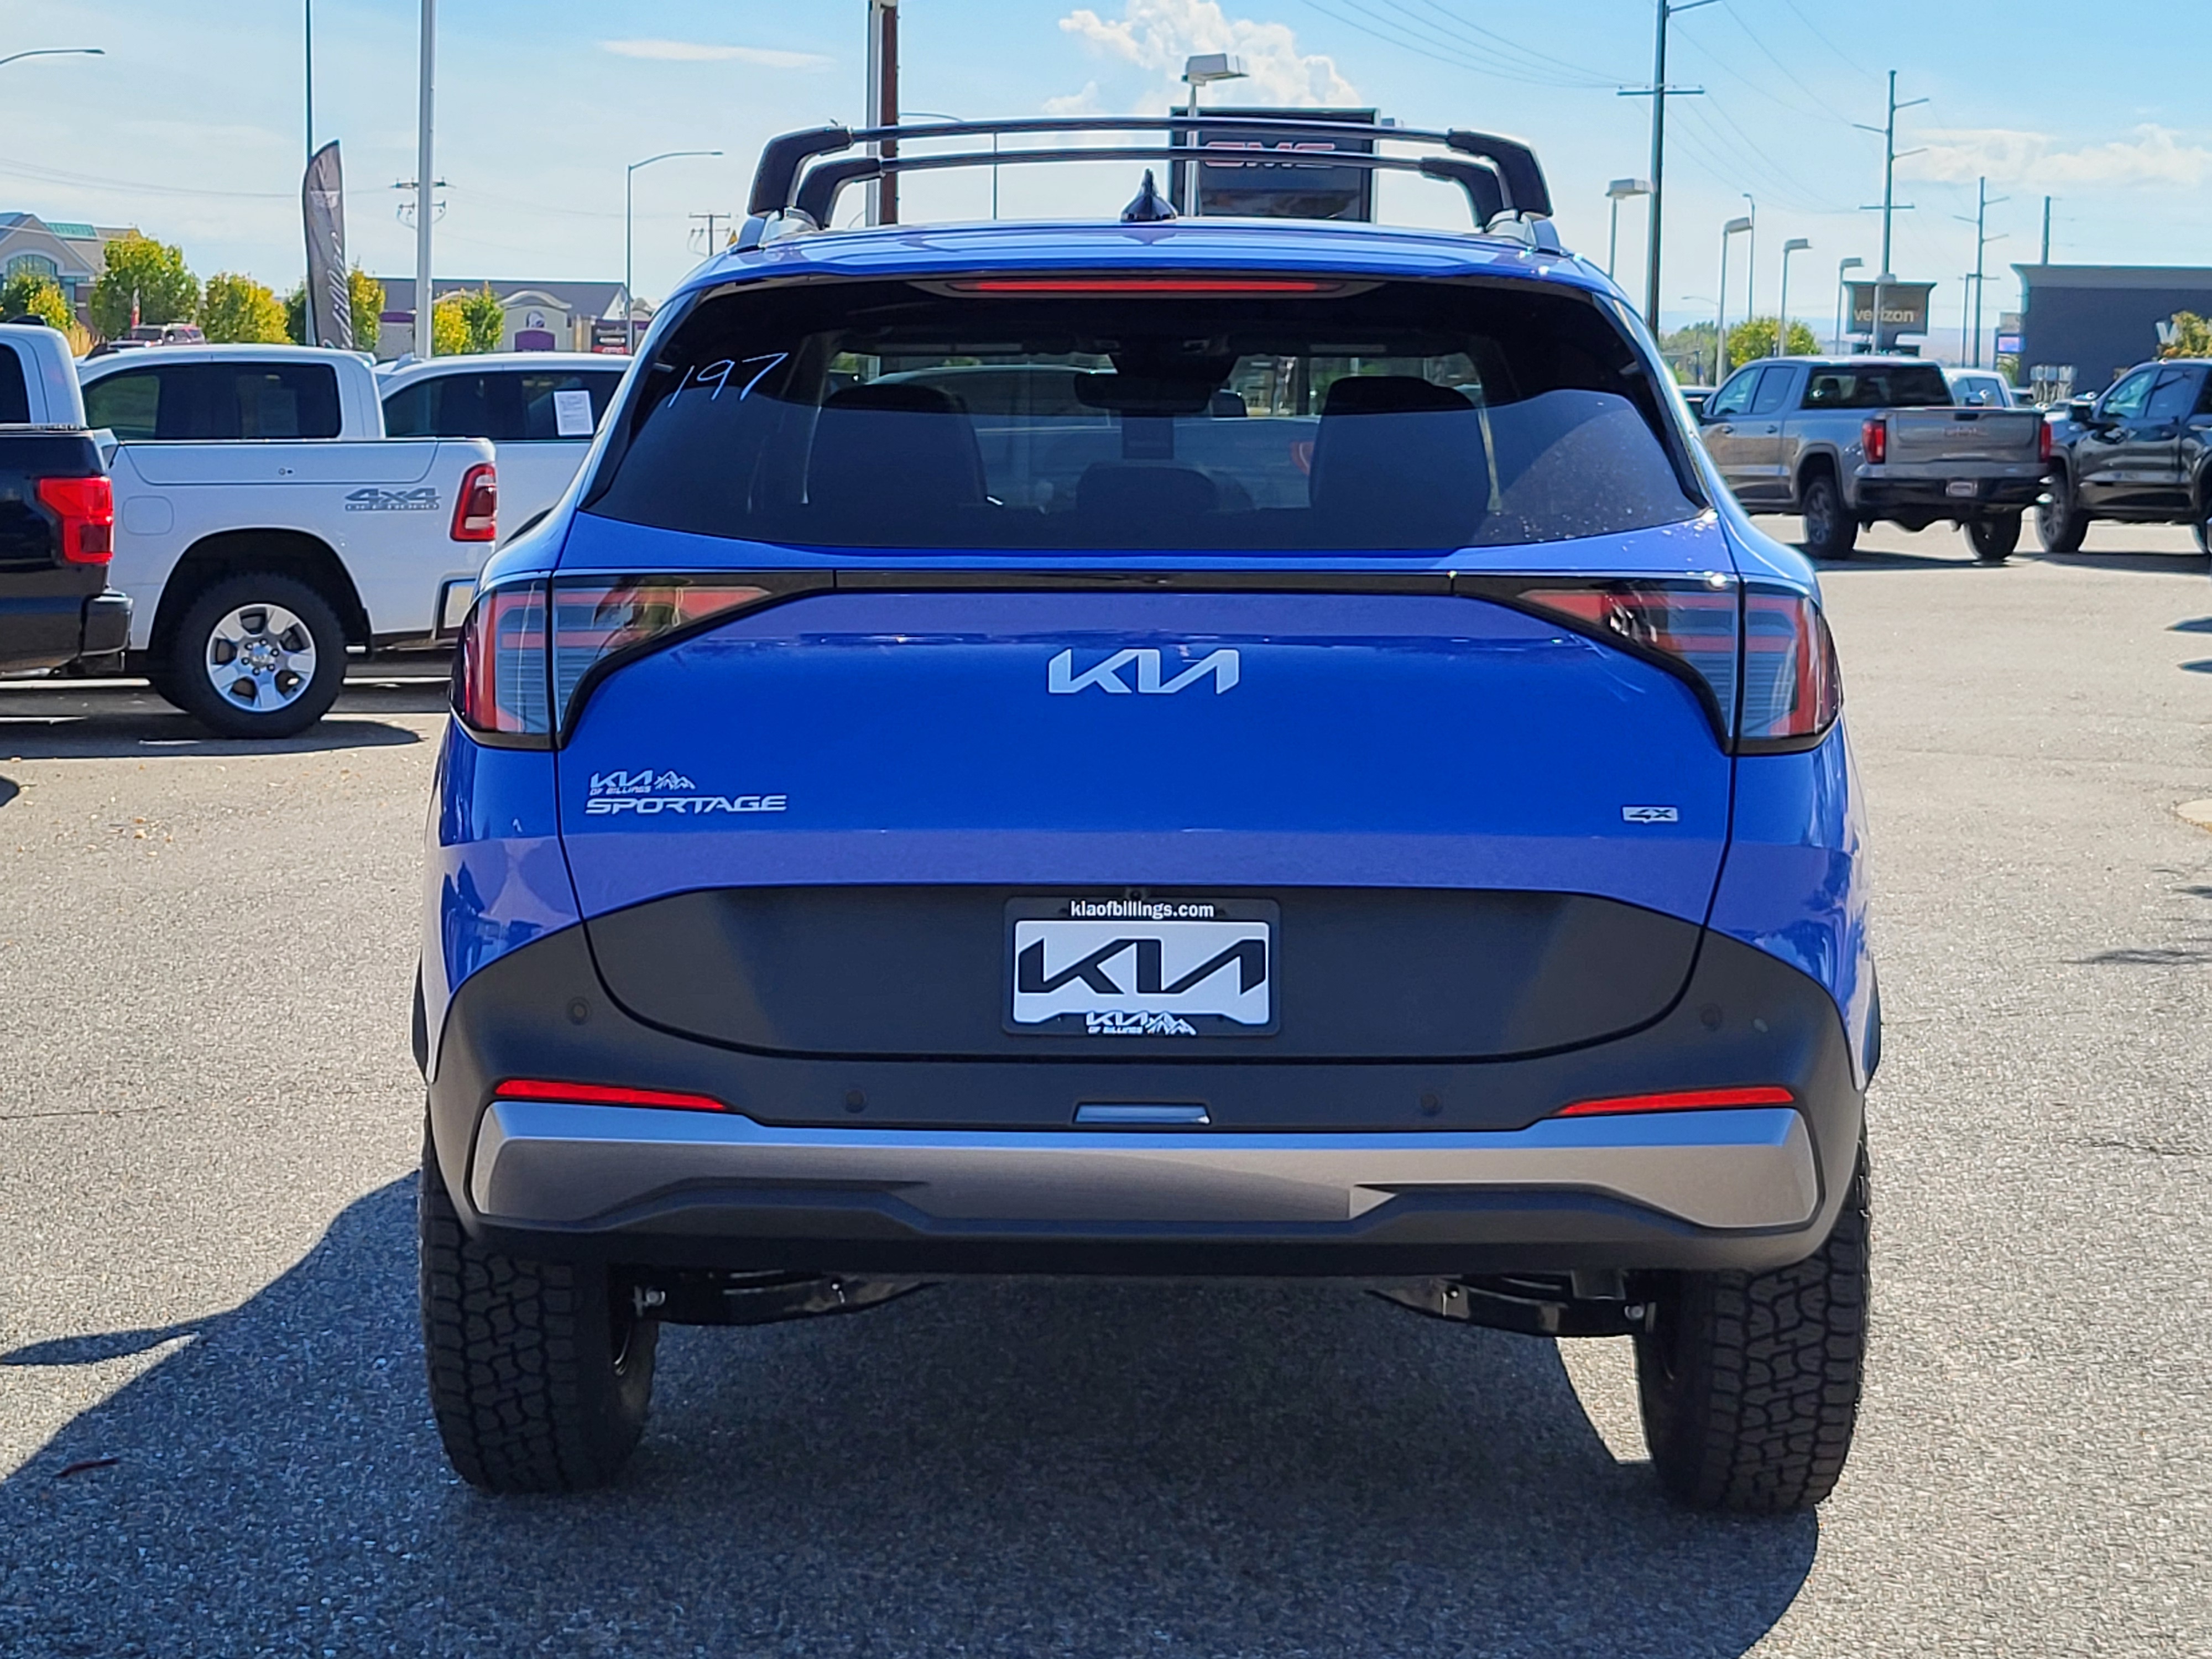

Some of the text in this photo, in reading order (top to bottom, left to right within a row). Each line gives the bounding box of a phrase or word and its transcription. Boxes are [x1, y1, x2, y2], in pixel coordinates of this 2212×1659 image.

[1854, 306, 1914, 322] veizon
[667, 352, 789, 408] 197
[1048, 649, 1239, 695] KIA
[590, 770, 654, 789] KIA
[585, 795, 787, 815] SPORTAGE
[1019, 938, 1266, 995] KIA
[1086, 1011, 1148, 1026] KIA
